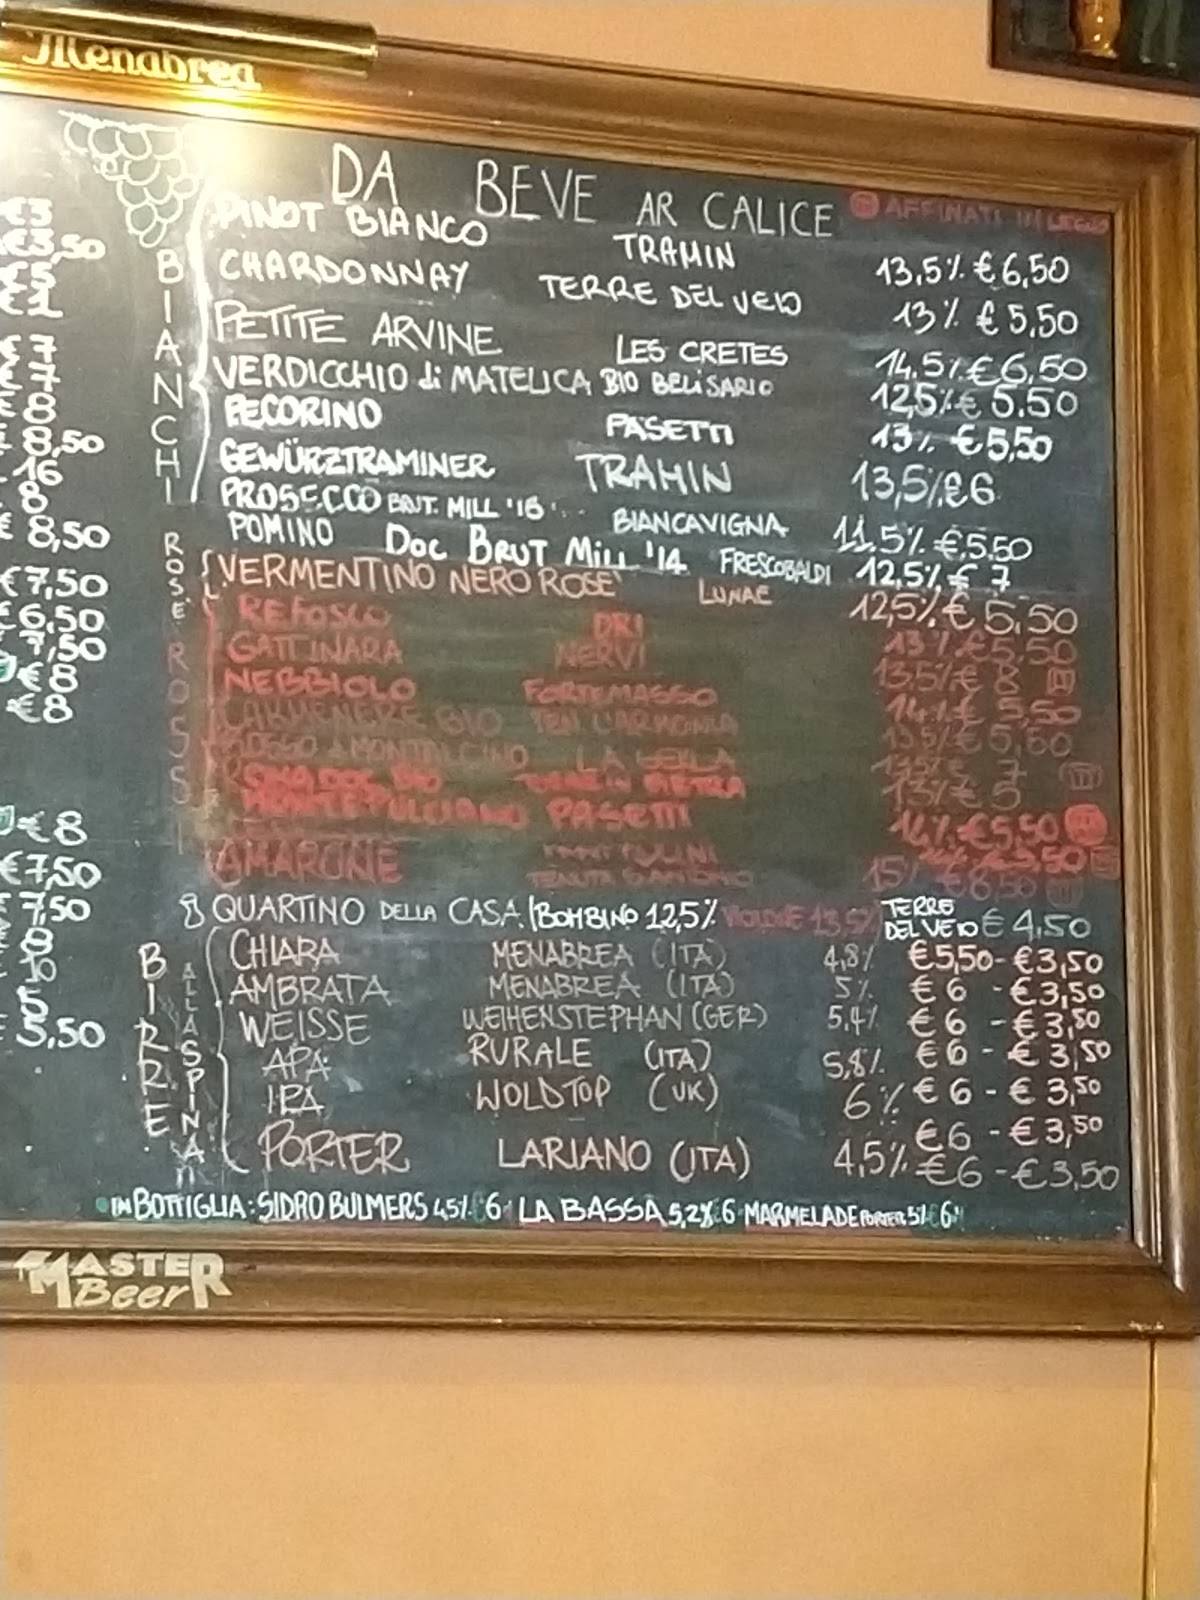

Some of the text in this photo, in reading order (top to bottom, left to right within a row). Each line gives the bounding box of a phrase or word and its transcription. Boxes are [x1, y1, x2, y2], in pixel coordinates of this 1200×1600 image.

[332, 142, 834, 237] DA BEVE AR CALICE
[346, 205, 488, 247] BIANCO
[613, 233, 735, 269] TRAMIN
[219, 249, 469, 294] CHARDONNAY
[539, 274, 658, 306] TERRE
[670, 284, 723, 309] DEL
[214, 299, 346, 343] PETITE
[371, 311, 502, 356] ARVINE
[617, 335, 665, 365] LES
[679, 341, 788, 367] CRETES
[213, 354, 408, 392] VERDICCHIO
[451, 364, 591, 396] MATELICA
[600, 368, 639, 396] BIO
[225, 395, 382, 430] PECORINO
[220, 437, 495, 479] GEWÜRZTRAMINER
[220, 475, 381, 514] PROSECCO
[447, 495, 500, 519] MILL
[613, 507, 789, 538] BIANCAVIGNA
[228, 510, 333, 546] POMINO
[719, 546, 832, 586] FRESCOBALDI
[217, 551, 435, 594] VERMENTINO
[450, 565, 532, 597] NERO
[211, 893, 365, 925] QUARTINO
[380, 899, 437, 923] DELLA
[880, 895, 955, 917] TERRE
[229, 929, 341, 971] CHIARA
[491, 939, 635, 971] MENABREA
[885, 921, 920, 941] DEL
[229, 972, 393, 1012] AMBRATA
[488, 970, 642, 1000] MENABREA
[238, 1006, 372, 1048] WEISSE
[461, 1003, 683, 1033] WEIHENSTEPHAN
[262, 1047, 332, 1082] APA
[468, 1031, 594, 1068] RURALE
[266, 1084, 325, 1117] IPA
[257, 1117, 411, 1176] PORTER
[498, 1135, 652, 1172] LARIANO
[329, 1190, 429, 1222] BULMERS
[518, 1195, 556, 1224] LA
[743, 1200, 859, 1230] MARMELADE
[13, 1249, 233, 1309] MASTER
[73, 1277, 190, 1309] Beer
